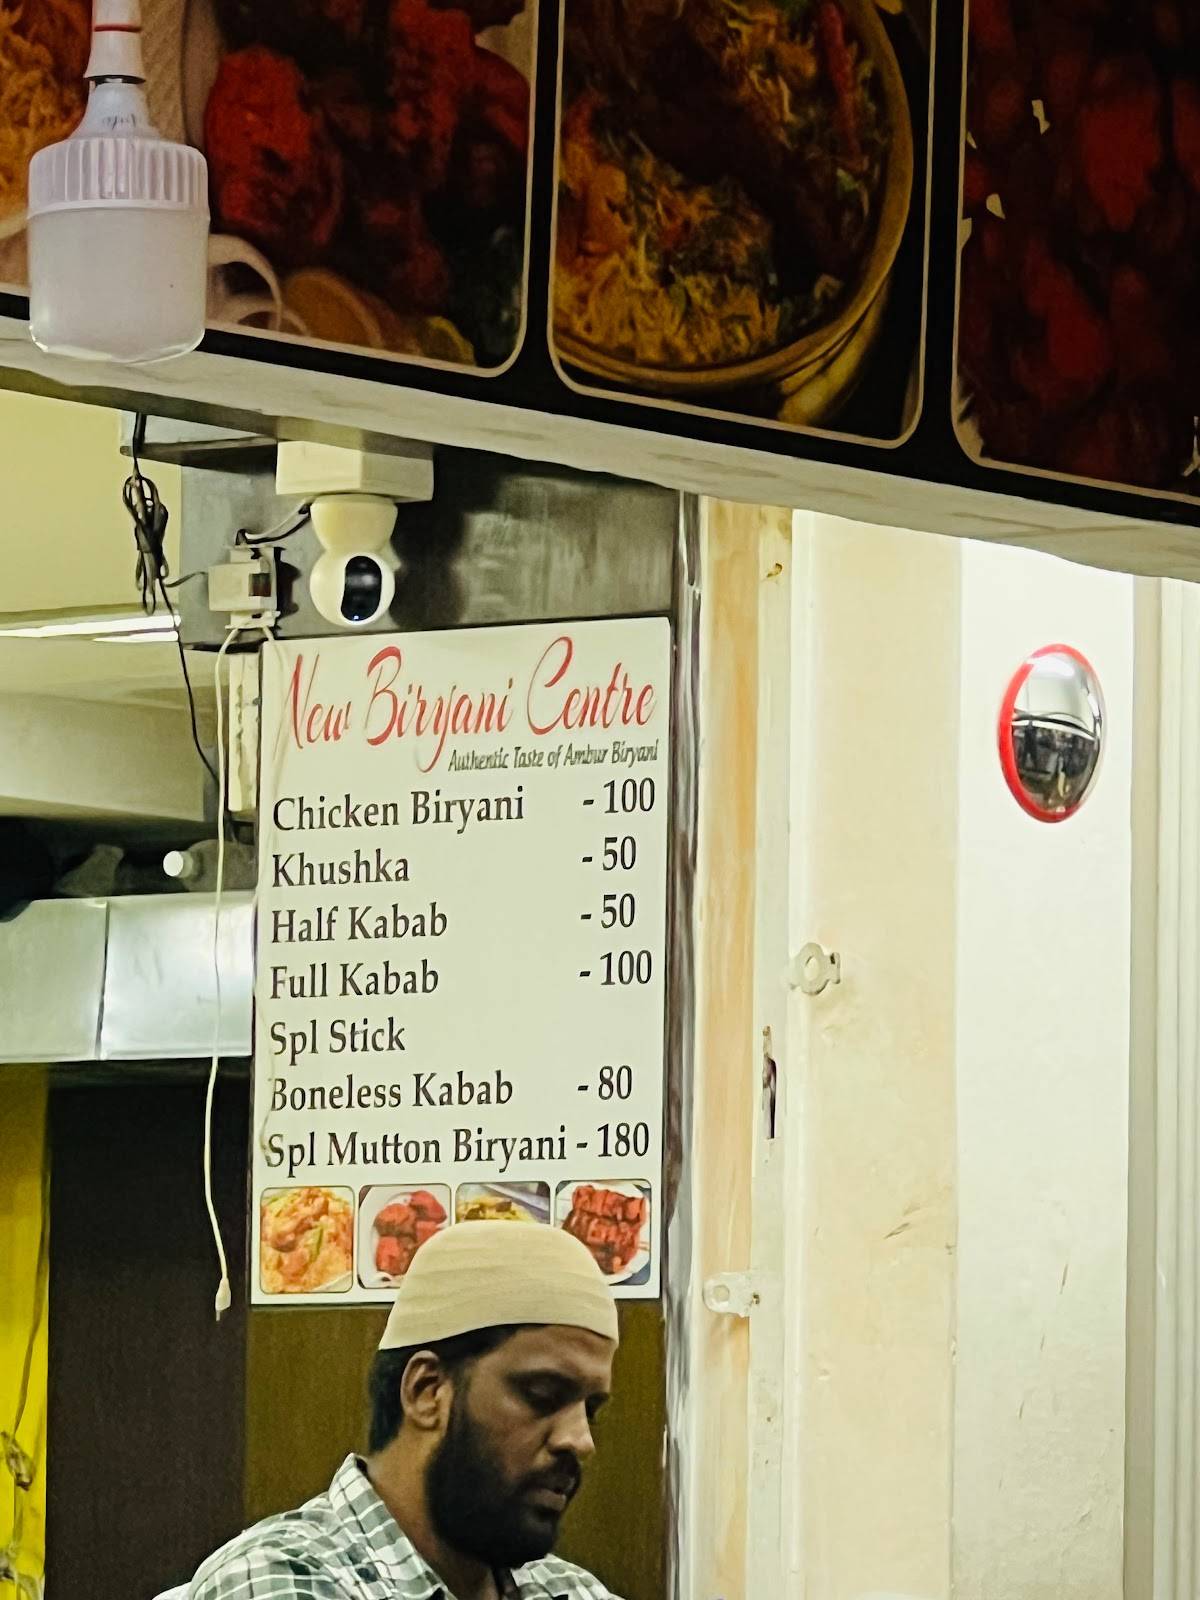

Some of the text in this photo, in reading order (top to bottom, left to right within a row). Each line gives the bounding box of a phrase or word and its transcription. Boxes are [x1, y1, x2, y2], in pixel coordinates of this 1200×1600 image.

[288, 636, 658, 773] New Biryani Centre
[448, 739, 660, 772] Authentic Taste of Ambur Biryani
[273, 794, 399, 831] Chicken
[411, 785, 525, 835] Biryani
[603, 777, 656, 814] 100
[272, 848, 410, 888] Khushka
[602, 835, 637, 871] 50
[271, 905, 339, 944] Half
[348, 901, 448, 941] Kabab
[600, 893, 636, 929] 50
[270, 962, 328, 1000] Full
[339, 958, 439, 997] Kabab
[599, 949, 652, 986] 100
[270, 1016, 406, 1067] Spl Stick
[270, 1073, 402, 1112] Boneless
[412, 1069, 513, 1107] Kabab
[598, 1065, 633, 1101] 80
[267, 1131, 316, 1179] Spl
[327, 1134, 441, 1166] Mutton
[453, 1124, 567, 1174] Biryani
[597, 1122, 650, 1158] 180
